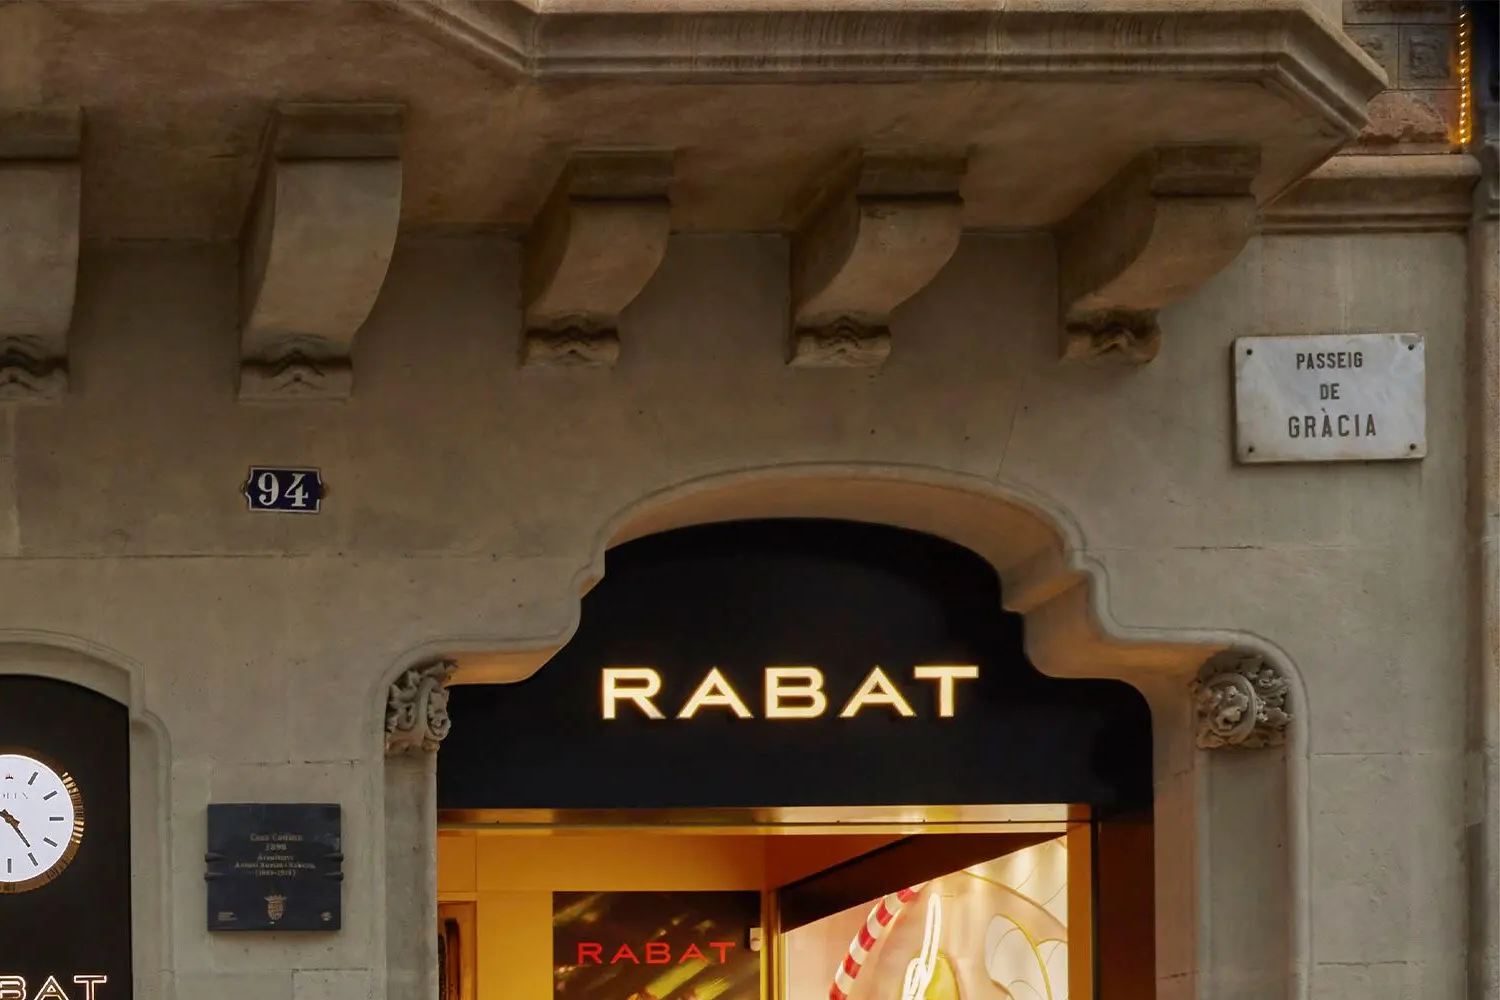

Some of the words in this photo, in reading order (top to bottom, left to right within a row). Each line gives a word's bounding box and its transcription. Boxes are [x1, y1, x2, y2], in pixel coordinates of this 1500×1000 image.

[1296, 351, 1363, 370] PASSEIG
[1319, 383, 1340, 400] DE
[1288, 408, 1377, 439] GRÀCIA
[257, 472, 309, 507] 94
[601, 665, 979, 720] RABAT
[577, 941, 736, 965] RABAT
